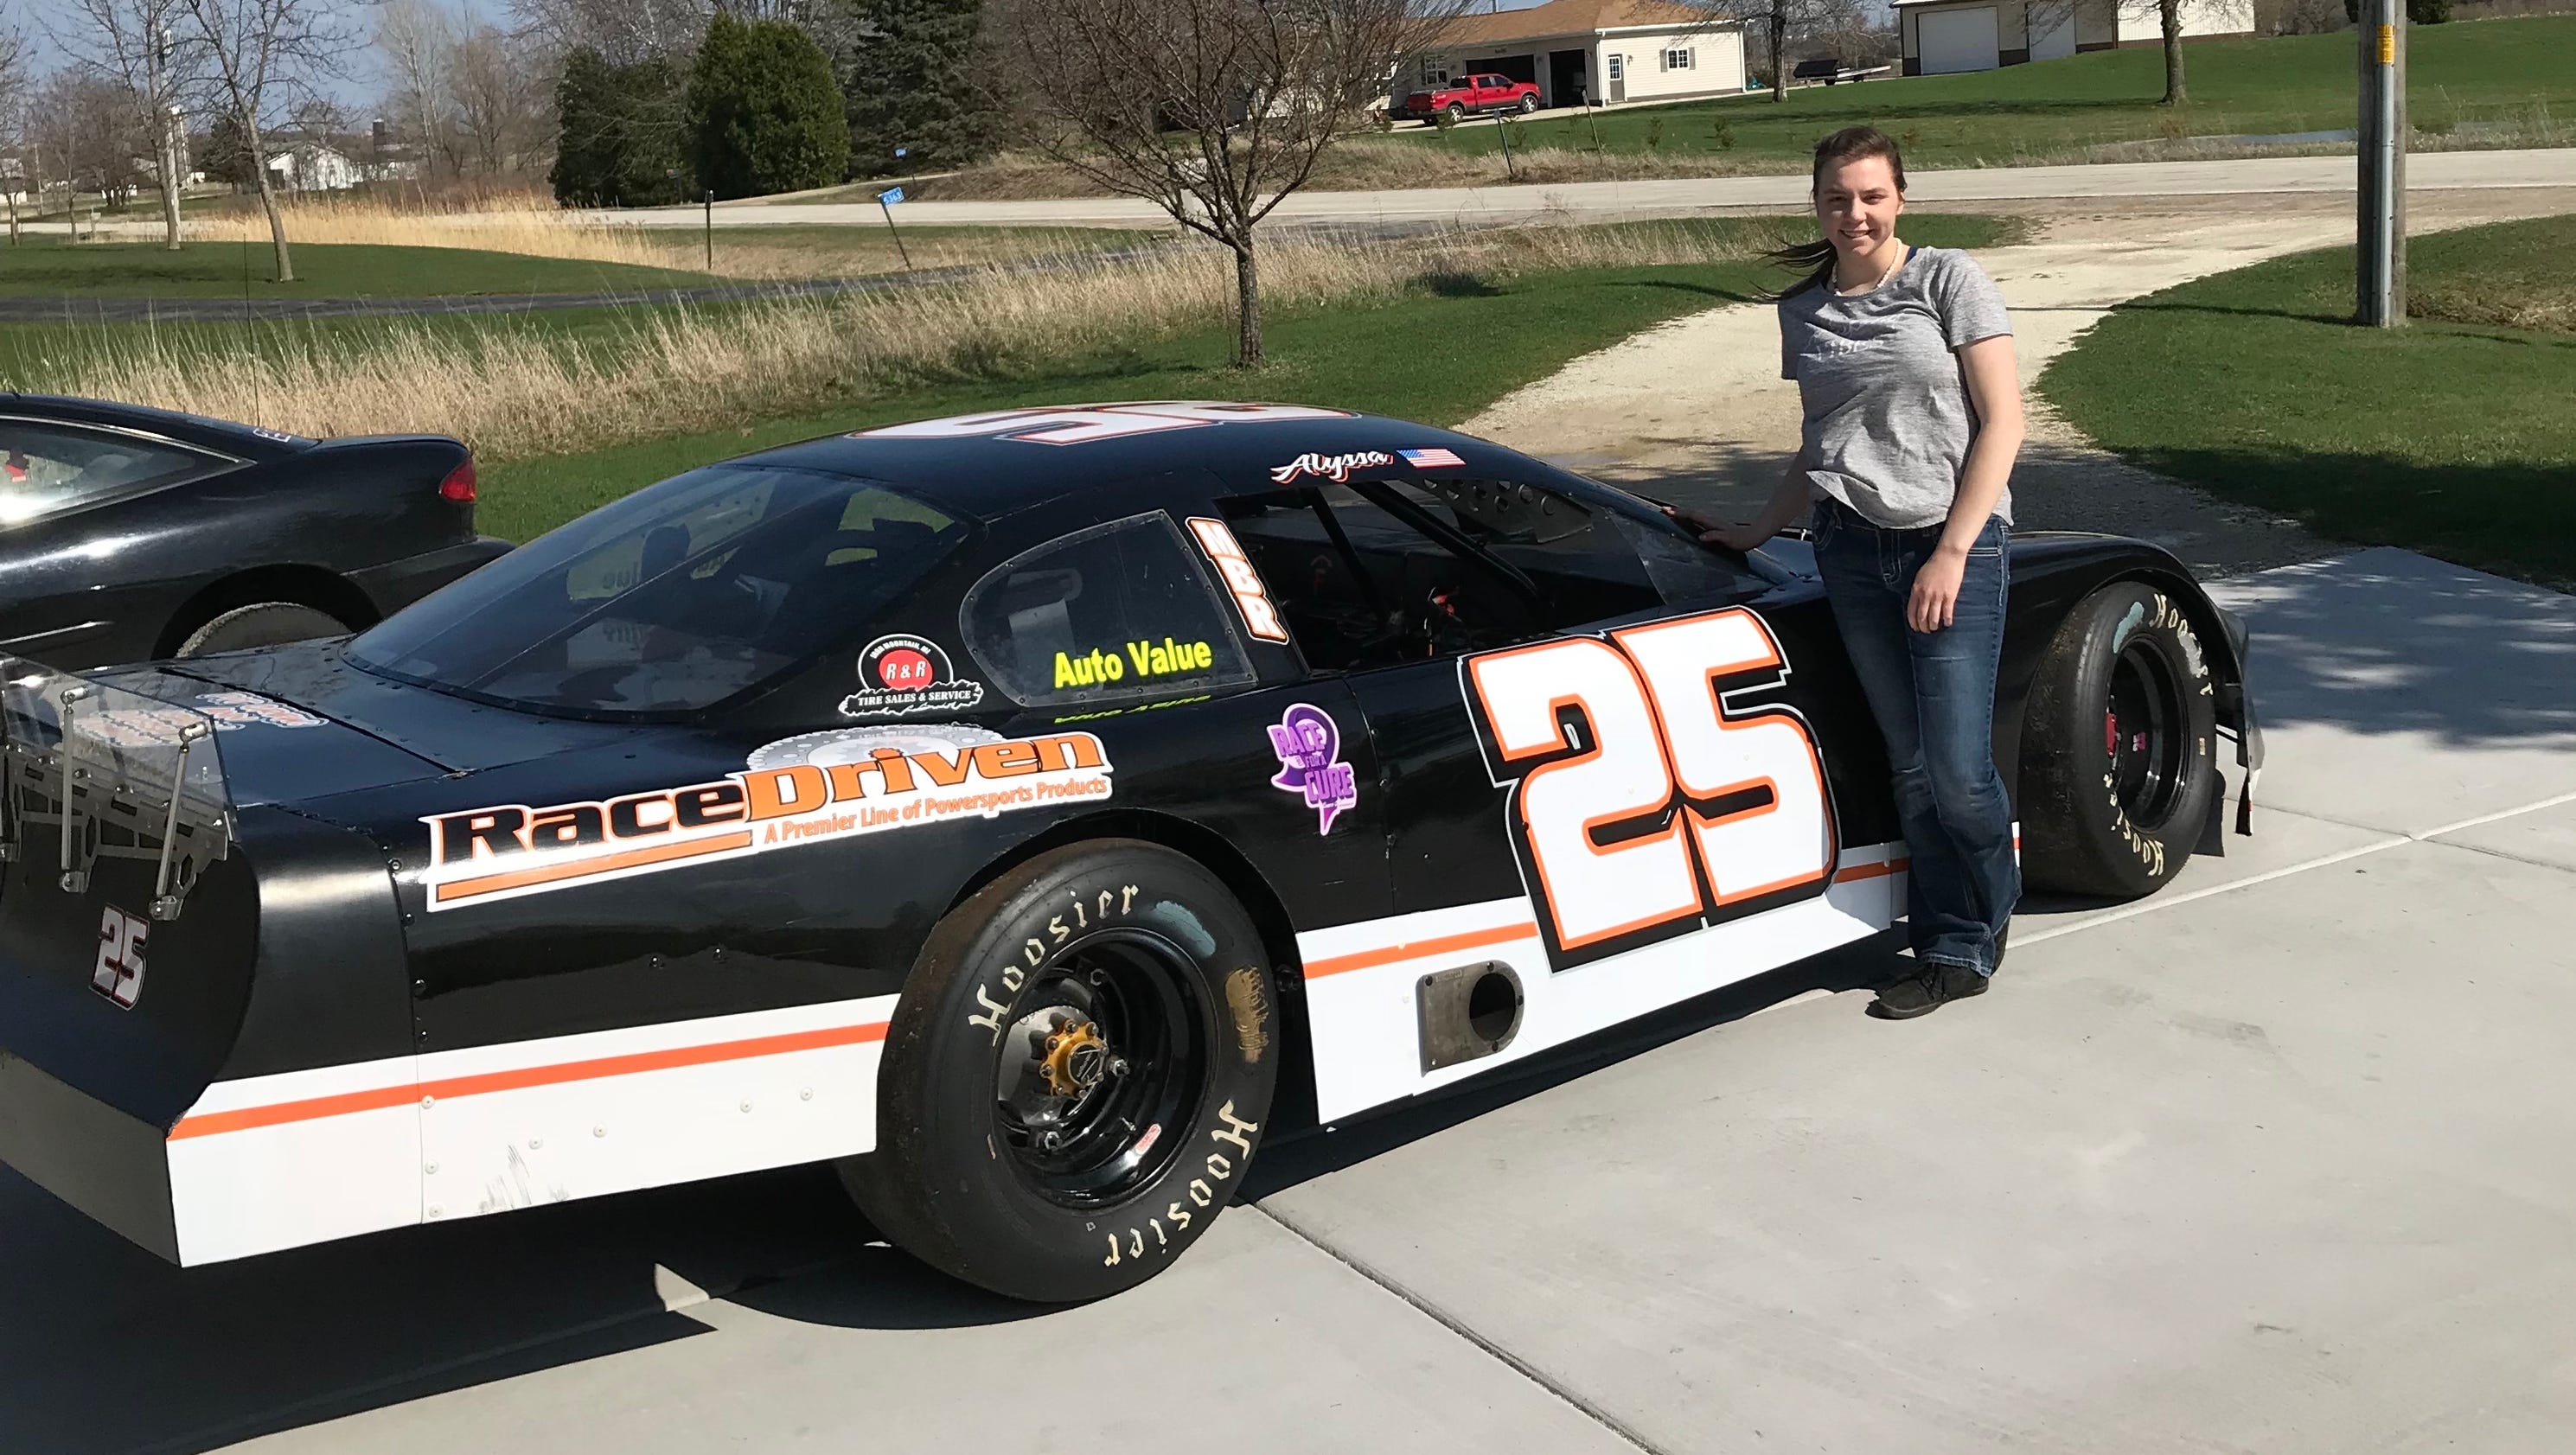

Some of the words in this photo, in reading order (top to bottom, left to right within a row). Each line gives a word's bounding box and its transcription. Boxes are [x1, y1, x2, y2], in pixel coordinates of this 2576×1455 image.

[1269, 450, 1394, 484] Alyssa
[885, 663, 898, 680] R
[899, 664, 911, 680] &
[915, 660, 927, 678] R
[1054, 648, 1123, 689] Auto
[1127, 637, 1212, 676] Value
[858, 695, 884, 706] TIRE
[885, 692, 917, 705] SALES
[917, 692, 927, 702] &
[928, 690, 972, 701] SERVICE
[1270, 723, 1326, 758] RACE
[1305, 755, 1322, 769] FOR
[1304, 765, 1355, 804] CURE
[1461, 607, 1840, 967] 25
[764, 823, 778, 845] A
[782, 813, 858, 841] Premier
[860, 806, 899, 827] Line
[902, 798, 922, 820] of
[924, 786, 1034, 816] Powersports
[1037, 777, 1108, 800] Products
[90, 903, 150, 1009] 25
[968, 883, 1140, 1048] Hoosier
[1103, 1099, 1258, 1267] Hoosier
